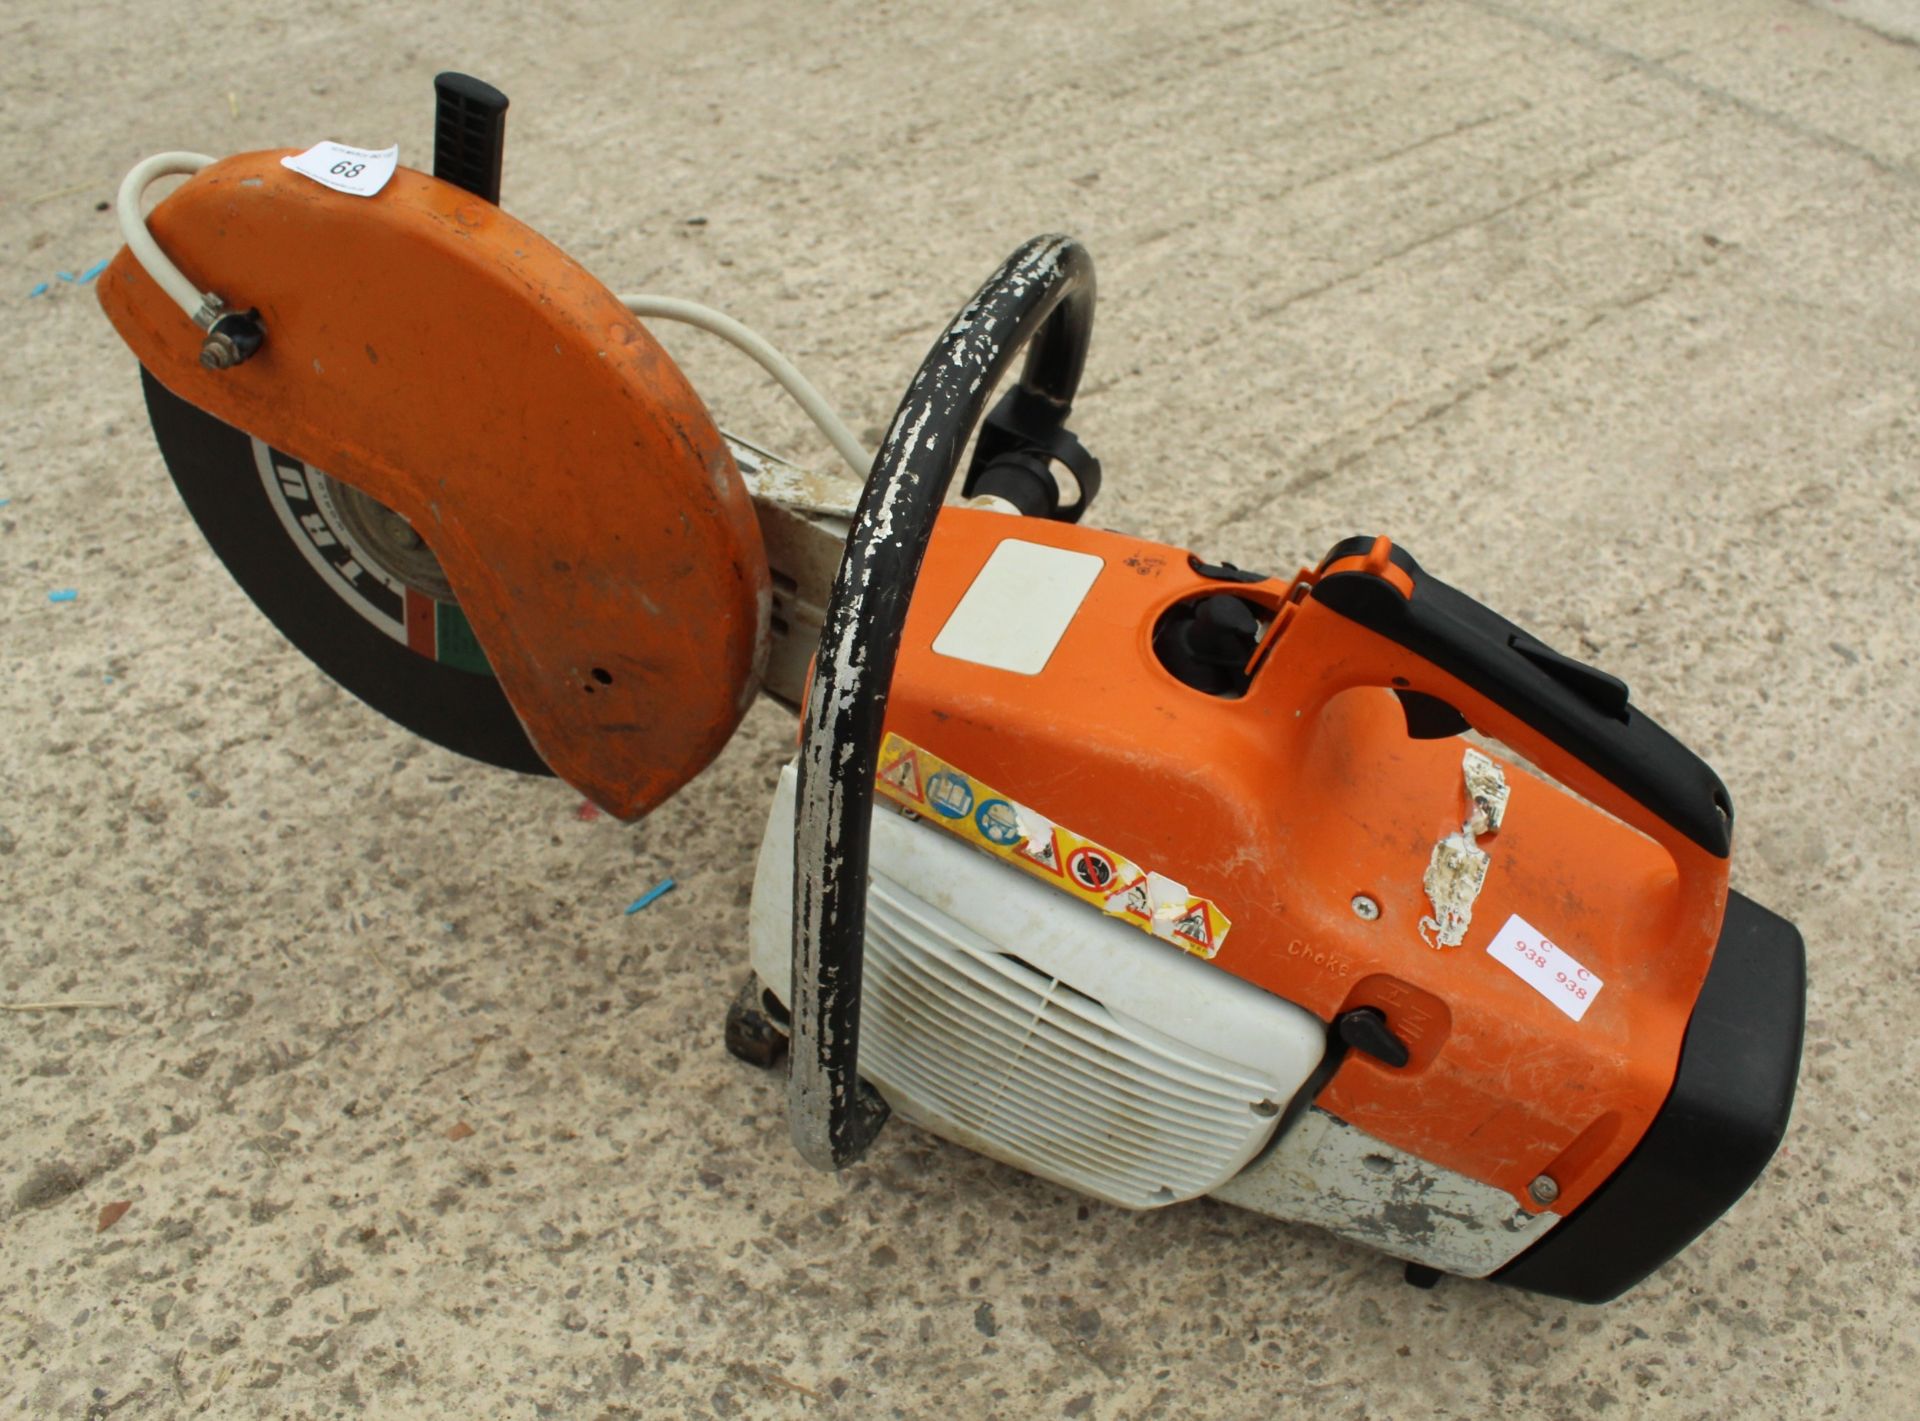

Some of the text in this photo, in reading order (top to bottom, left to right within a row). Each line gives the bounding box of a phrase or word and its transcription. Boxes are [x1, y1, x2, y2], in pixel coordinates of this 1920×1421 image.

[329, 160, 366, 178] 68
[1514, 940, 1587, 1000] 938 938
[1540, 940, 1590, 981] C C
